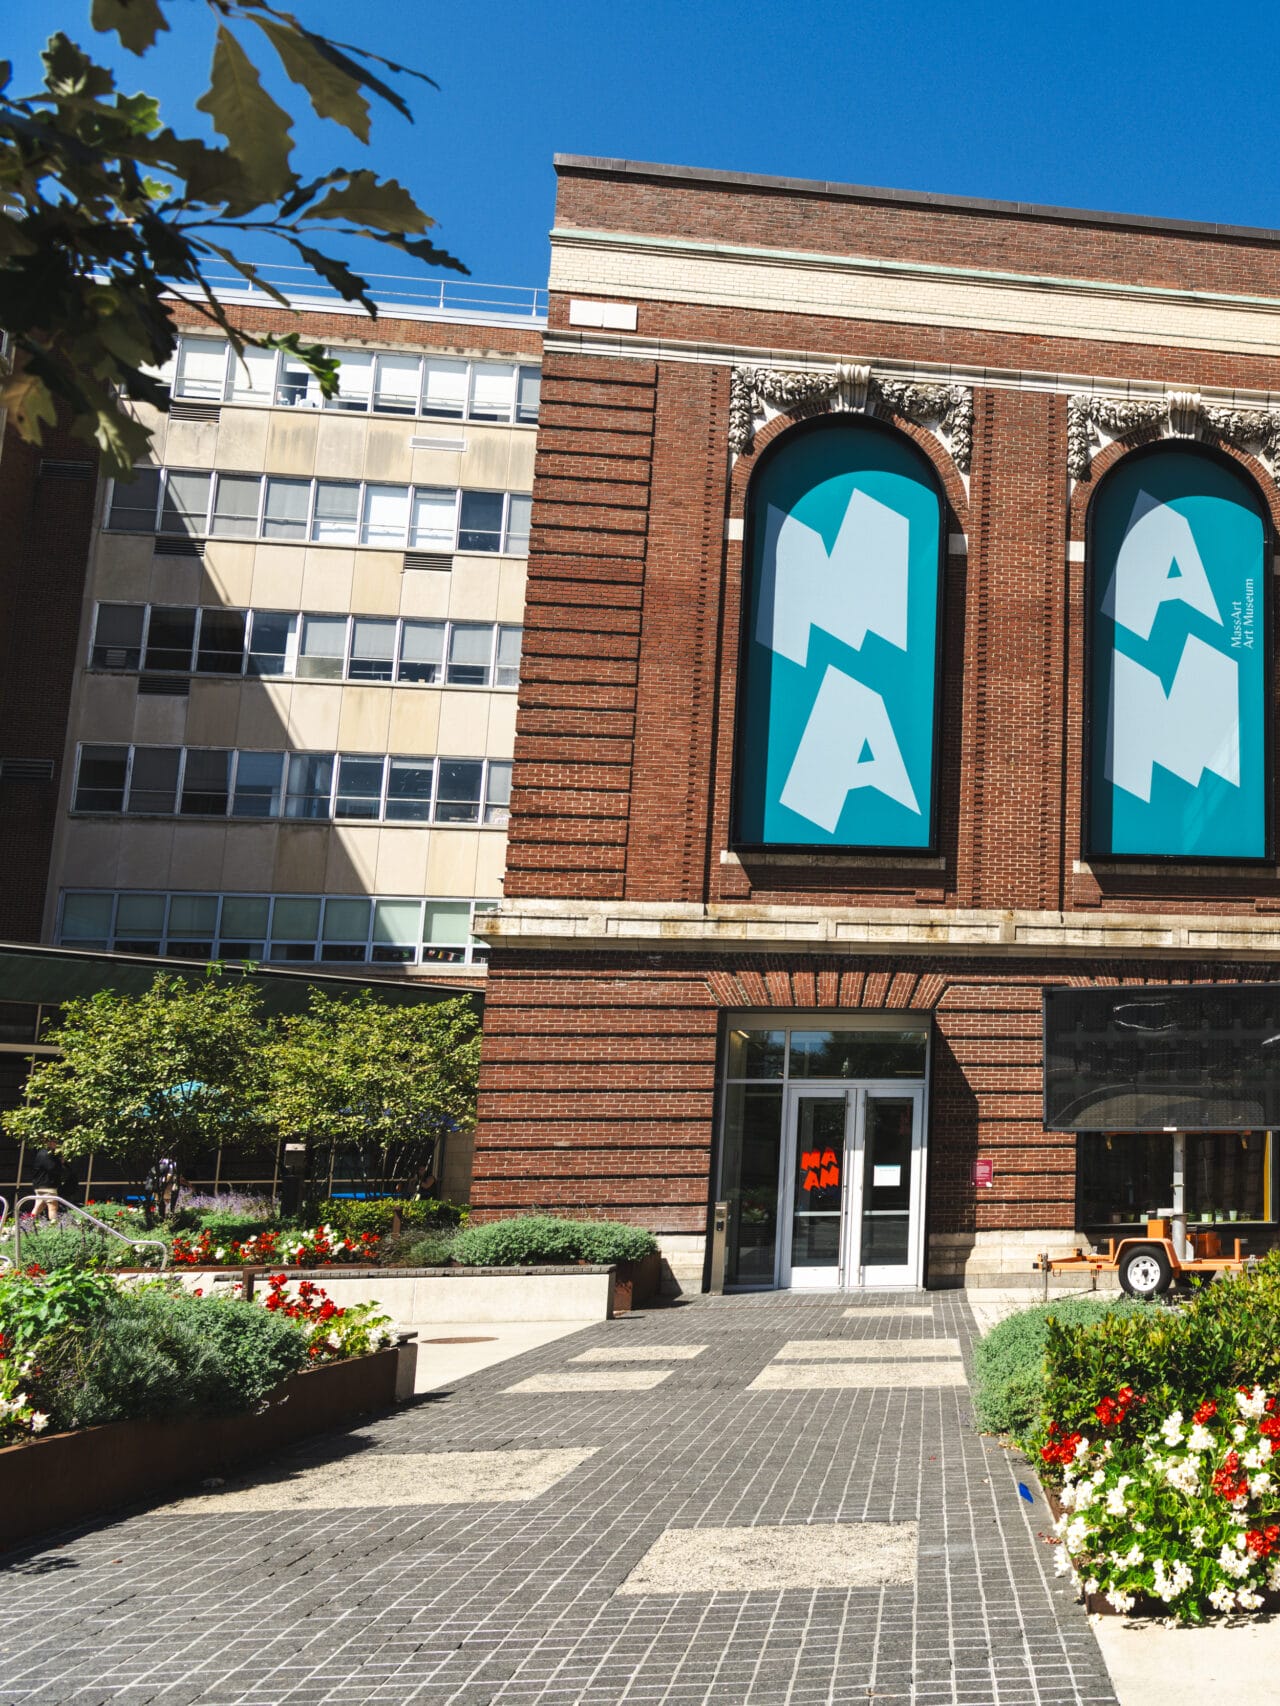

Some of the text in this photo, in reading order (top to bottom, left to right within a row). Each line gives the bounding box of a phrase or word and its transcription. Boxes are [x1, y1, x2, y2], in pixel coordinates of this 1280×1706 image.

[1231, 601, 1242, 648] MassArt
[1243, 578, 1254, 650] Art Museum
